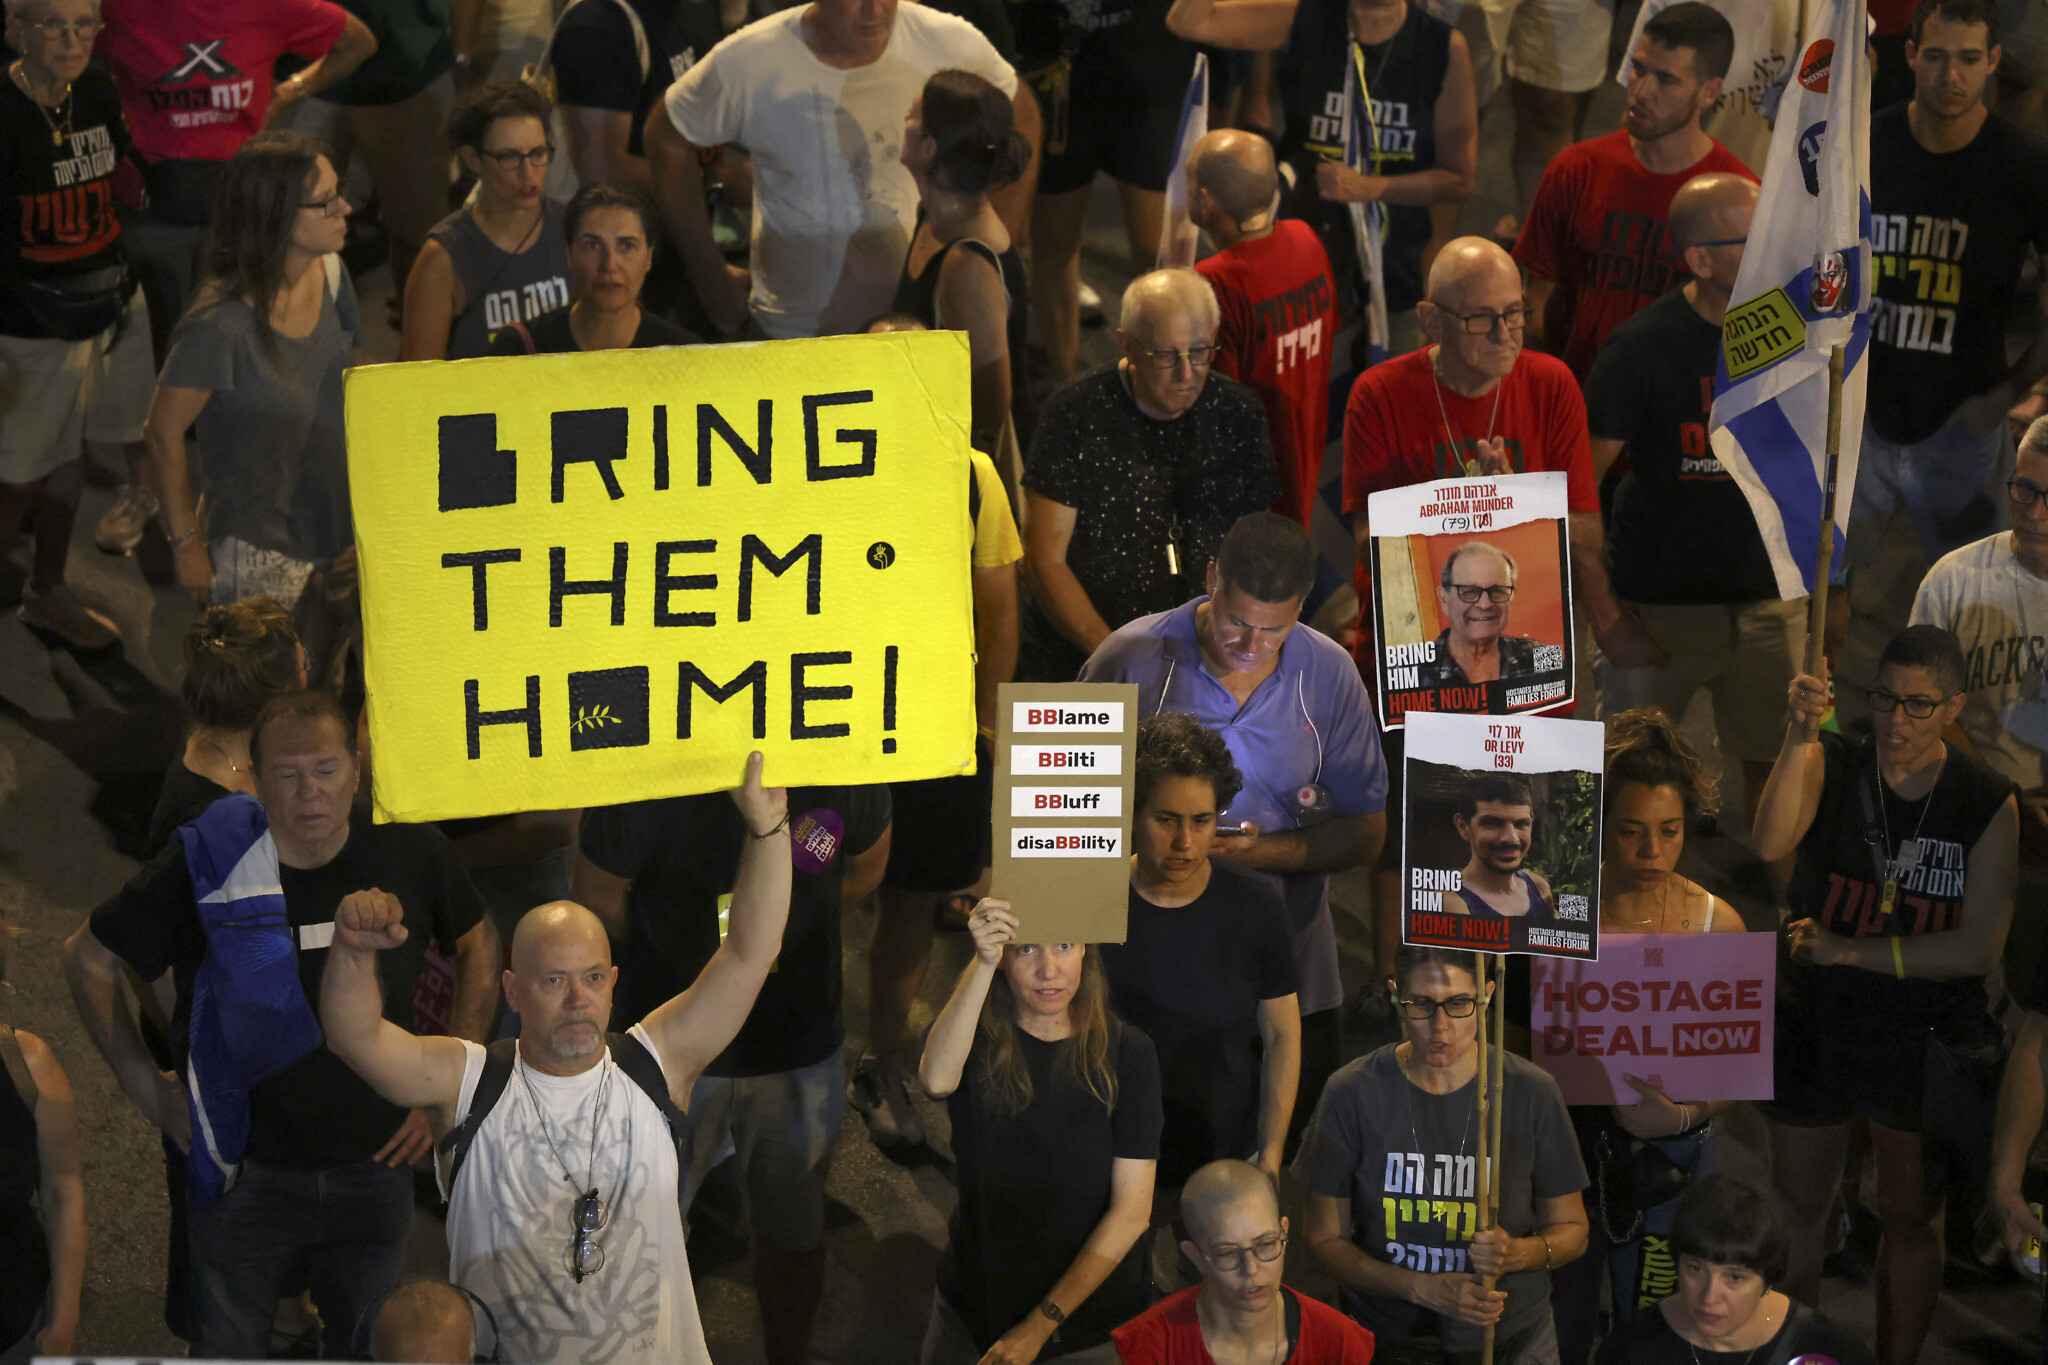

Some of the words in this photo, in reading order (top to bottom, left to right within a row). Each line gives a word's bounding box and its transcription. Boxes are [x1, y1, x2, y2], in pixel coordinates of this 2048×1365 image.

[1801, 53, 1832, 78] CRIM
[1803, 66, 1831, 87] MINIS
[1324, 91, 1409, 128] בוחם
[1870, 213, 1908, 253] הם
[1910, 214, 1969, 263] למה
[1871, 254, 1961, 305] עדיין
[485, 289, 520, 330] הם
[523, 275, 569, 321] למה
[1725, 304, 1780, 342] הנהגה
[1730, 326, 1792, 366] חדשה
[438, 389, 877, 512] BRING
[1434, 486, 1461, 501] מונדר
[1464, 484, 1498, 499] אברהם
[1420, 501, 1470, 517] ABRAHAM
[1472, 496, 1513, 512] MUNDER
[1442, 516, 1470, 531] (79)
[441, 533, 823, 632] THEM
[1385, 641, 1436, 667] BRING
[1387, 666, 1419, 690] HIM
[1506, 685, 1531, 697] HOSTAGES
[1532, 683, 1543, 693] AND
[464, 645, 899, 761] HOME!
[1388, 690, 1436, 715] HOME
[1440, 683, 1488, 711] NOW!
[1506, 690, 1539, 707] FAMILIES
[1540, 686, 1566, 701] FORUM
[1028, 709, 1110, 725] BBlame
[1489, 724, 1502, 738] לוי
[1506, 726, 1522, 739] אור
[1484, 740, 1498, 753] OR
[1500, 741, 1524, 754] LEVY
[1039, 752, 1095, 767] BBilti
[1494, 754, 1514, 769] (33)
[1035, 794, 1101, 809] BBluff
[1017, 836, 1117, 852] disaBBility
[1411, 868, 1462, 892] BRING
[1411, 890, 1443, 913] HIM
[1411, 914, 1457, 938] HOME
[1462, 917, 1510, 942] NOW!
[1528, 927, 1555, 938] HOSTAGES
[1555, 930, 1566, 938] AND
[1566, 931, 1590, 941] MISSING
[1528, 934, 1562, 948] FAMILIES
[1562, 938, 1590, 951] FORUM
[1543, 979, 1763, 1013] HOSTAGE
[1543, 1025, 1668, 1056] DEAL
[1678, 1026, 1755, 1051] NOW
[1384, 1152, 1425, 1195] הם
[1433, 1154, 1491, 1198] מה
[1386, 1241, 1470, 1274] עזה?
